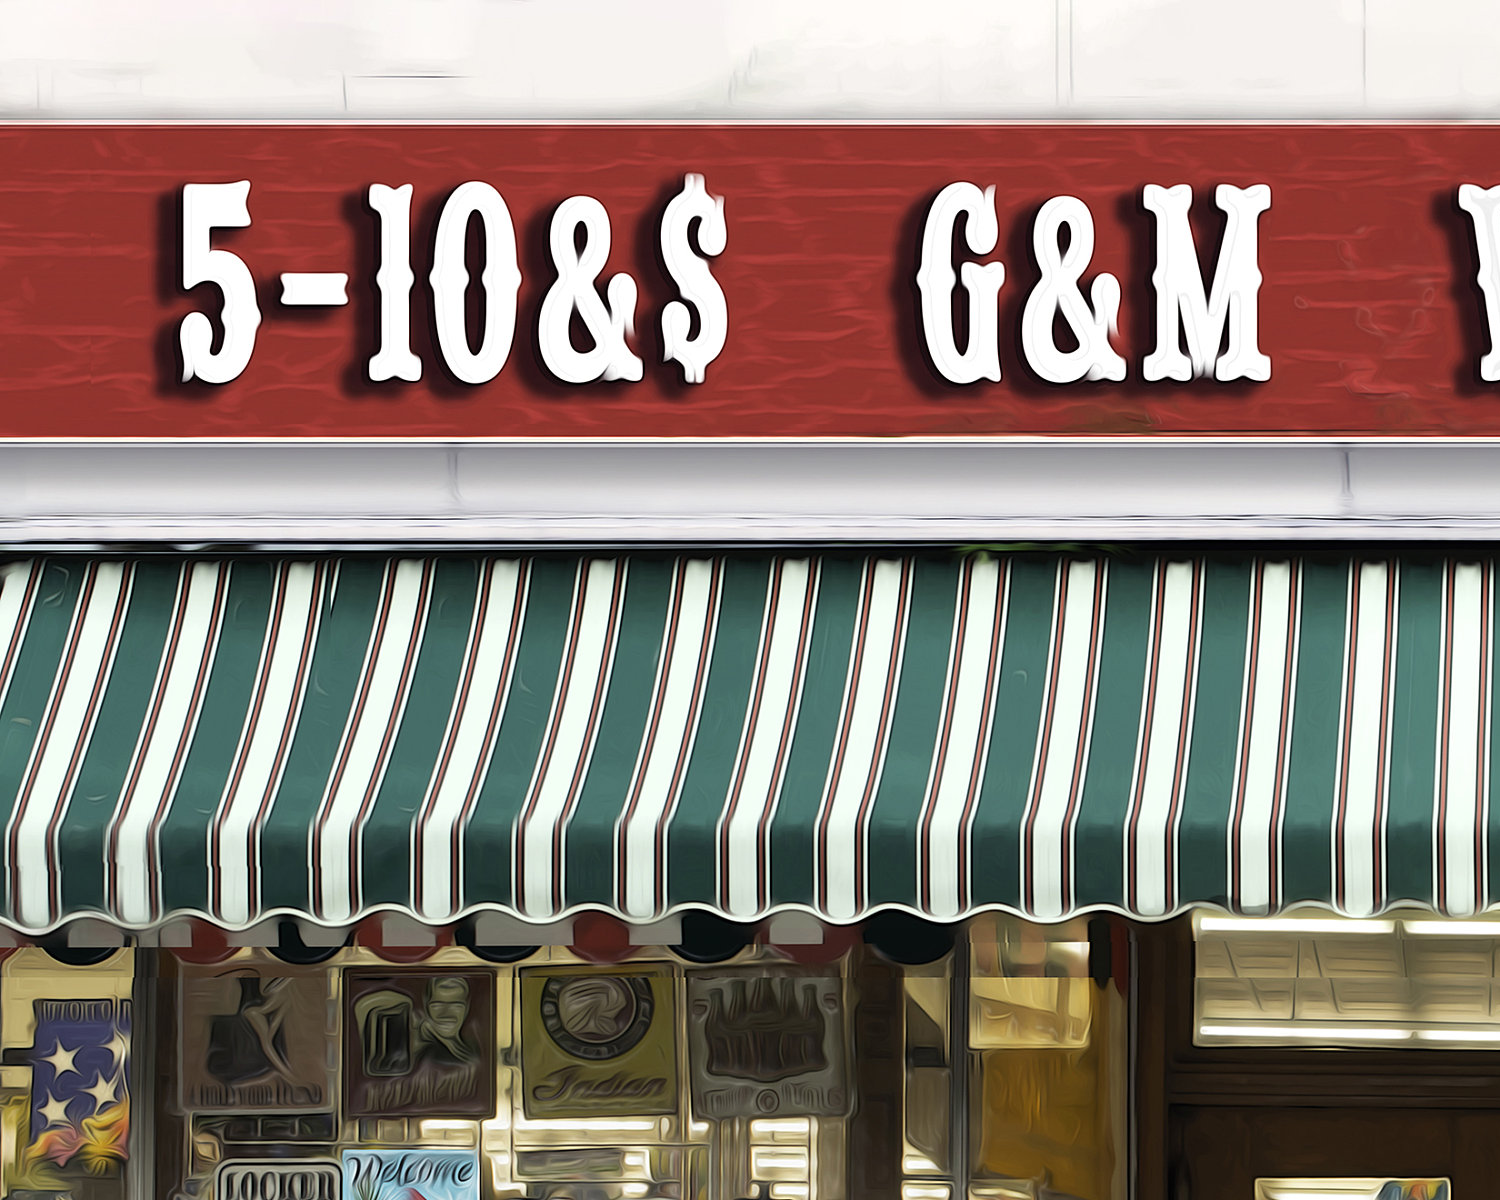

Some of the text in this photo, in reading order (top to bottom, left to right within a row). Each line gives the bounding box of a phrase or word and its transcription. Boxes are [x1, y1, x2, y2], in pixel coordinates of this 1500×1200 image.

[180, 173, 728, 384] 5-10&$
[917, 181, 1272, 384] G&M
[345, 1153, 474, 1187] Welcome
